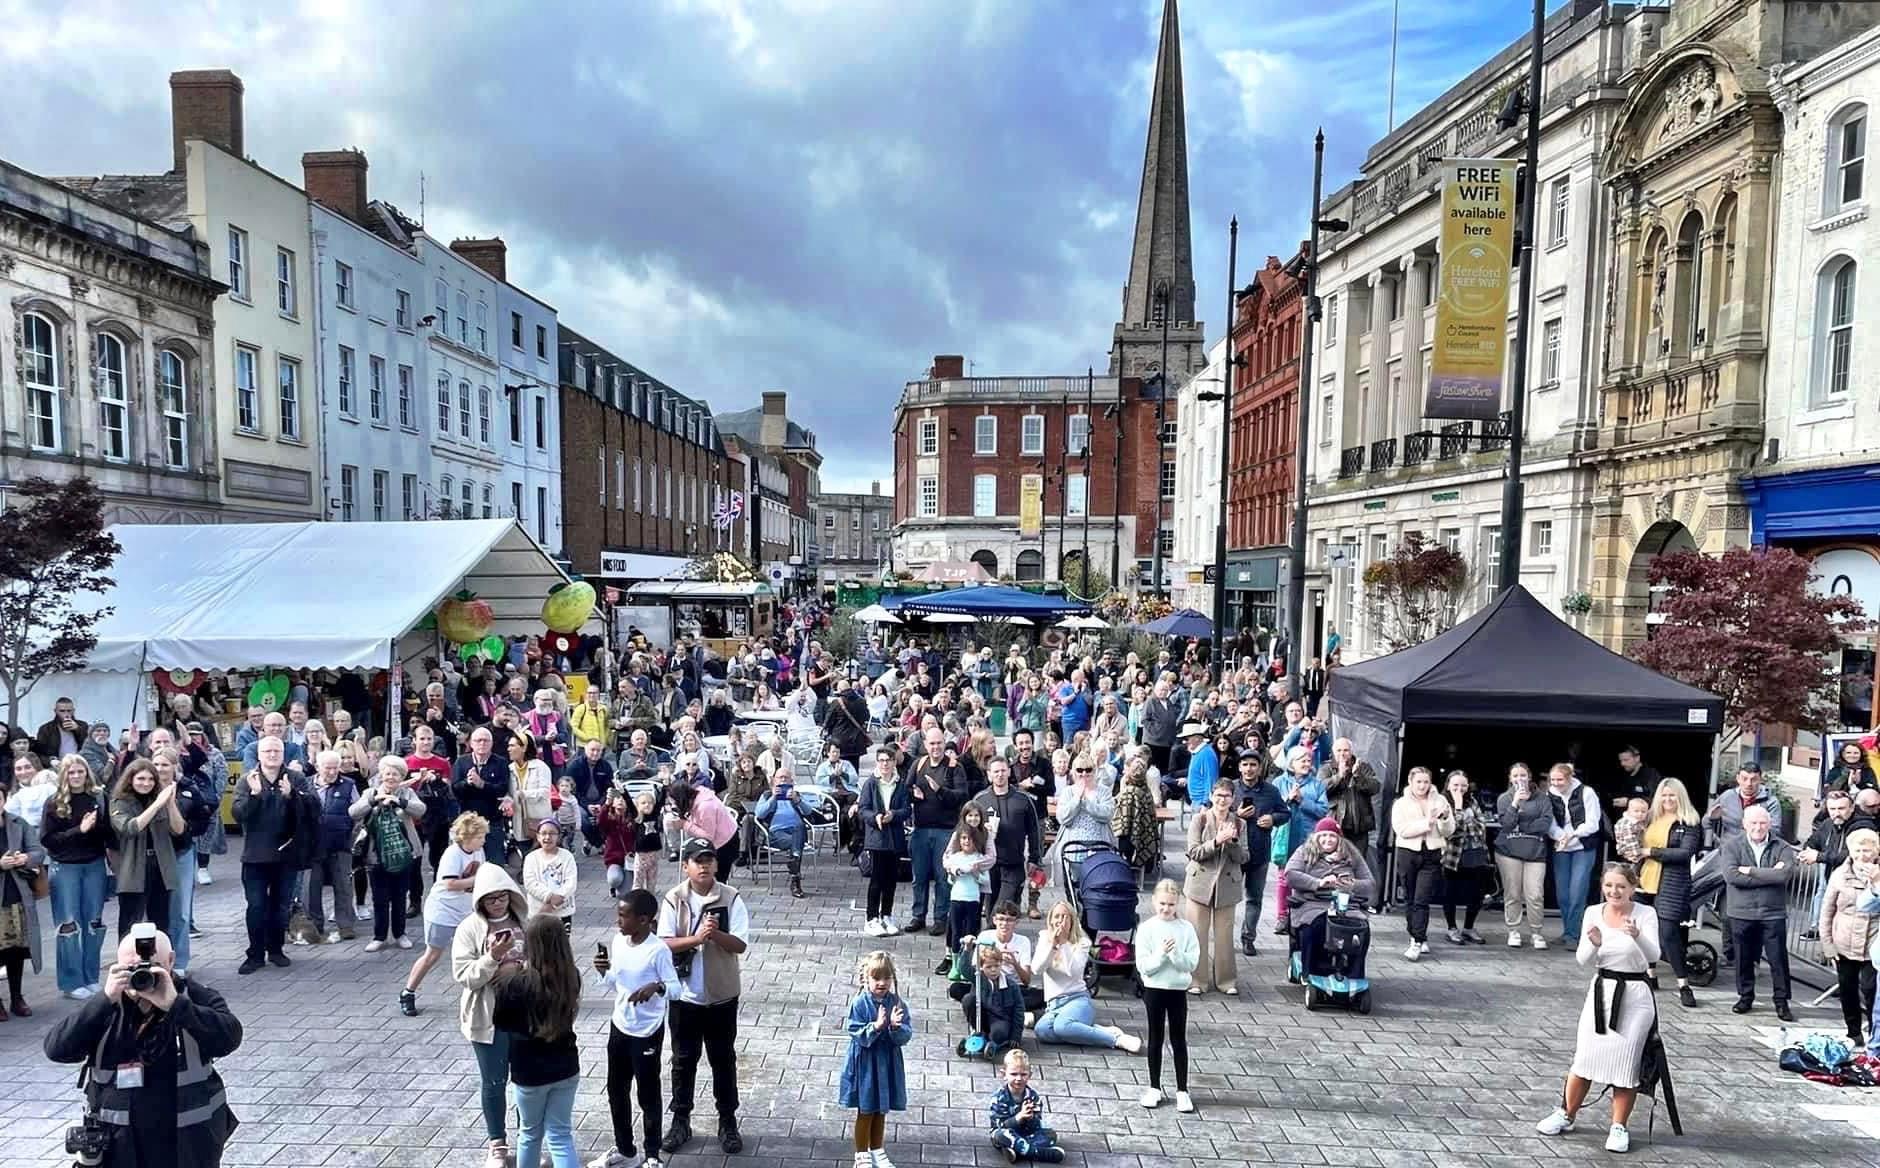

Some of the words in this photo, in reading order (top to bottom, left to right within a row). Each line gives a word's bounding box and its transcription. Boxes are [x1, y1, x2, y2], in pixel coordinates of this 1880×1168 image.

[1457, 167, 1501, 183] FREE
[1459, 186, 1499, 201] WiFi
[1450, 207, 1506, 219] available
[1464, 222, 1492, 235] here
[1451, 264, 1501, 277] Hereford
